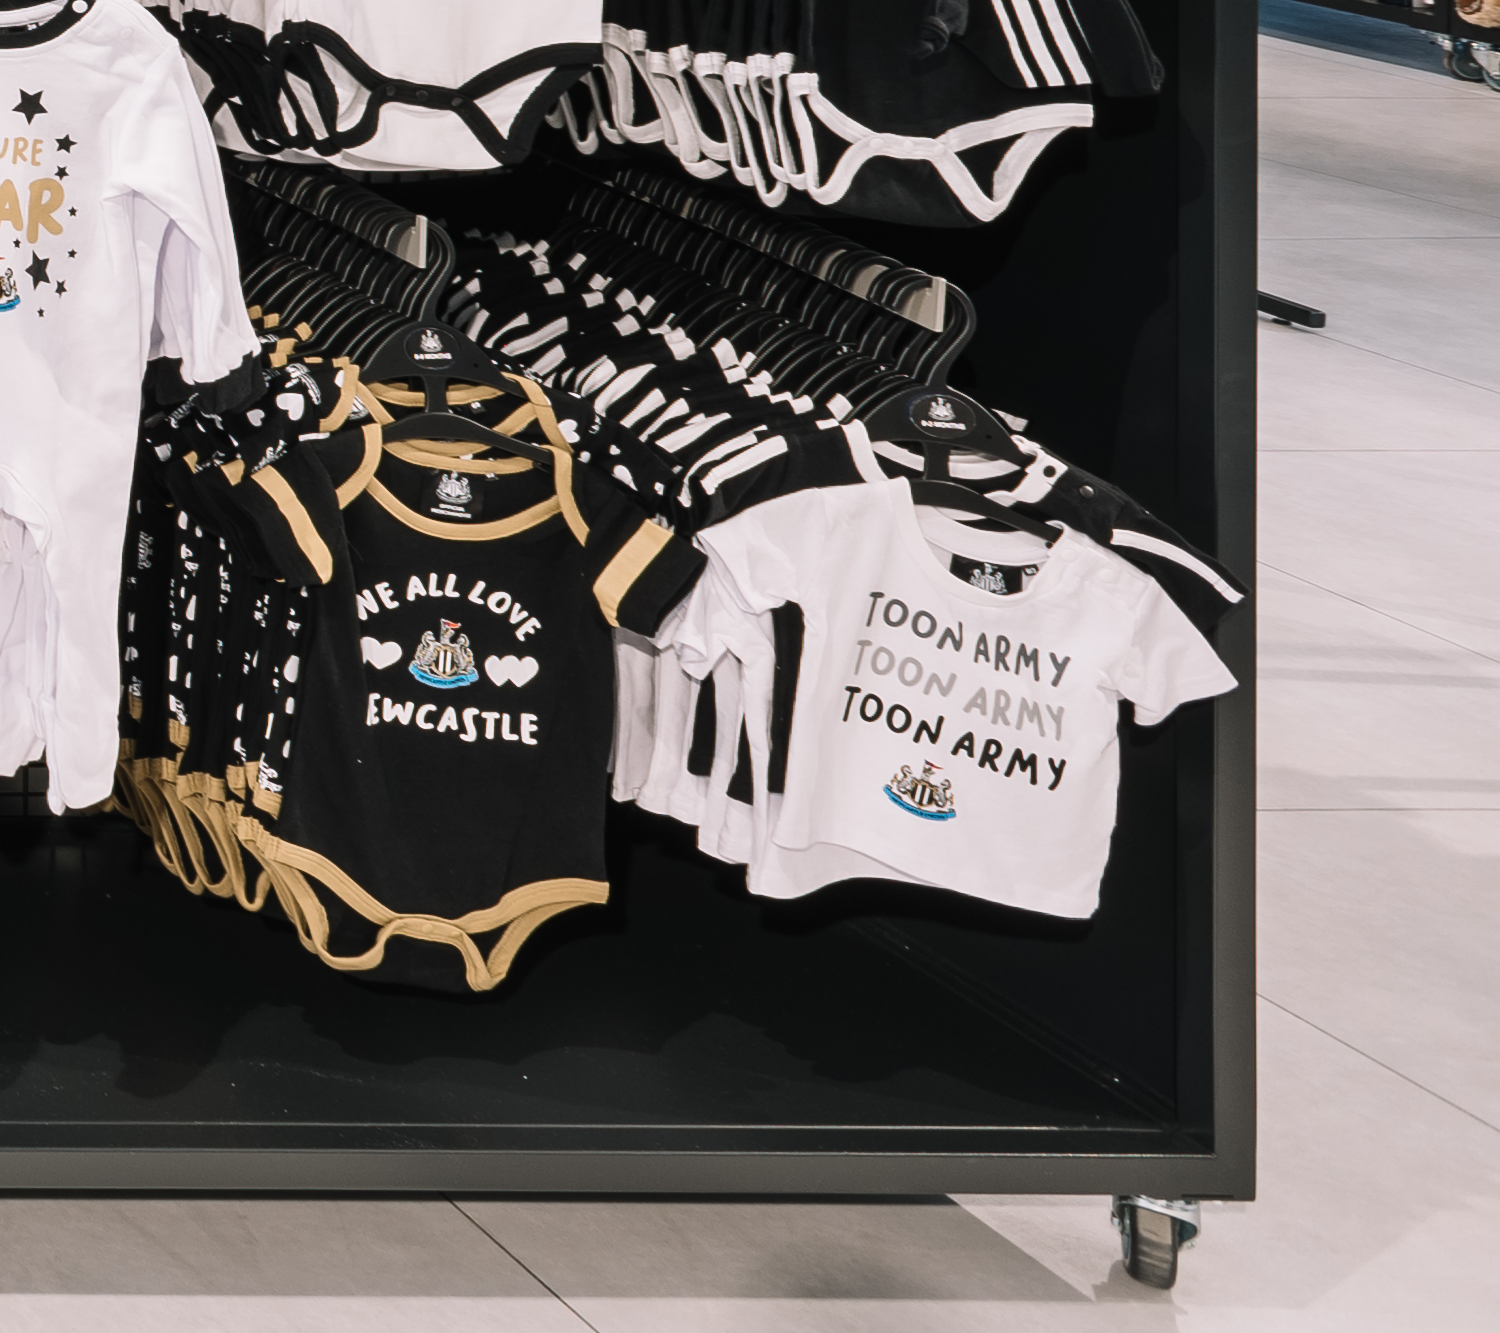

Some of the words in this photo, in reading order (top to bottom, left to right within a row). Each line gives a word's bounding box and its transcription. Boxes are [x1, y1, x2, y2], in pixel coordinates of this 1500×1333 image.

[407, 572, 461, 602] ALL
[467, 580, 543, 642] LOVE
[865, 591, 963, 652] TOON
[973, 632, 1071, 688] ARMY
[366, 693, 539, 745] EWCASTLE
[842, 685, 945, 745] TOON
[950, 731, 1067, 792] ARMY
[854, 640, 957, 697] TOON
[962, 686, 1065, 742] ARMY
